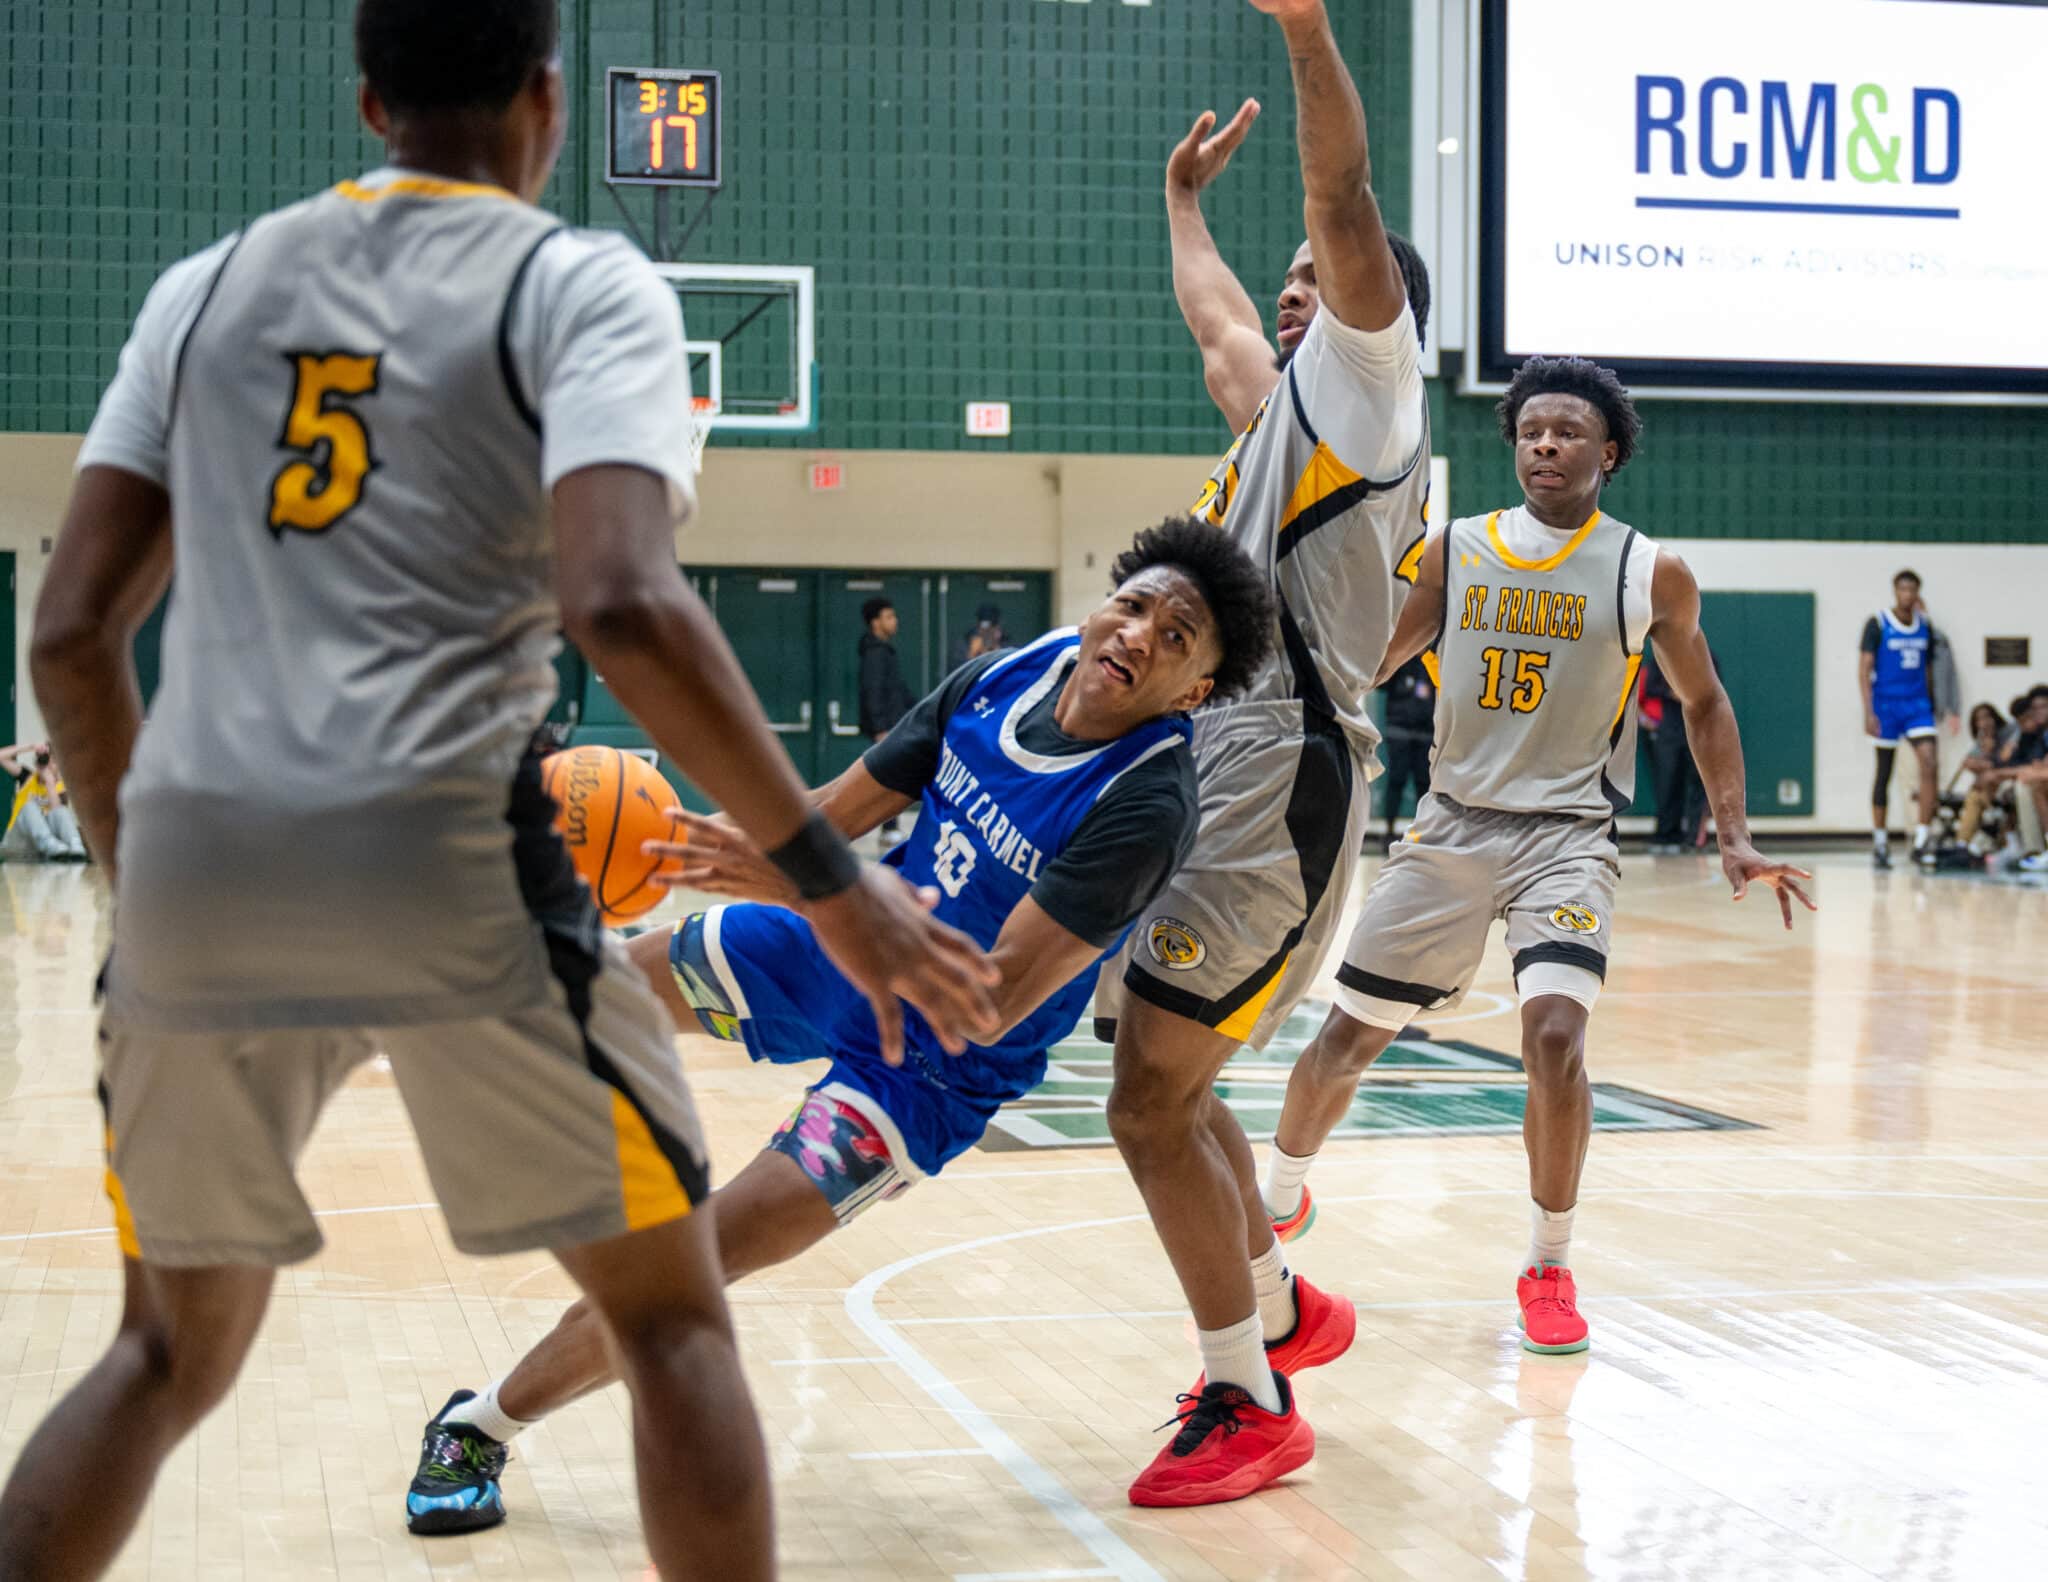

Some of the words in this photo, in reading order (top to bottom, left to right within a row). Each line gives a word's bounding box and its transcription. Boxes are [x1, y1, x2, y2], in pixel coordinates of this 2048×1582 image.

[639, 80, 707, 115] 3:15
[649, 115, 698, 170] 17
[1634, 73, 1961, 186] RCM&D
[1554, 242, 1685, 268] UNISON
[268, 350, 384, 543] 5
[1460, 584, 1489, 631] ST.
[1494, 587, 1588, 641] FRANCES
[1478, 646, 1551, 714] 15
[934, 736, 981, 808] OUNT
[966, 791, 1043, 882] CARMEL
